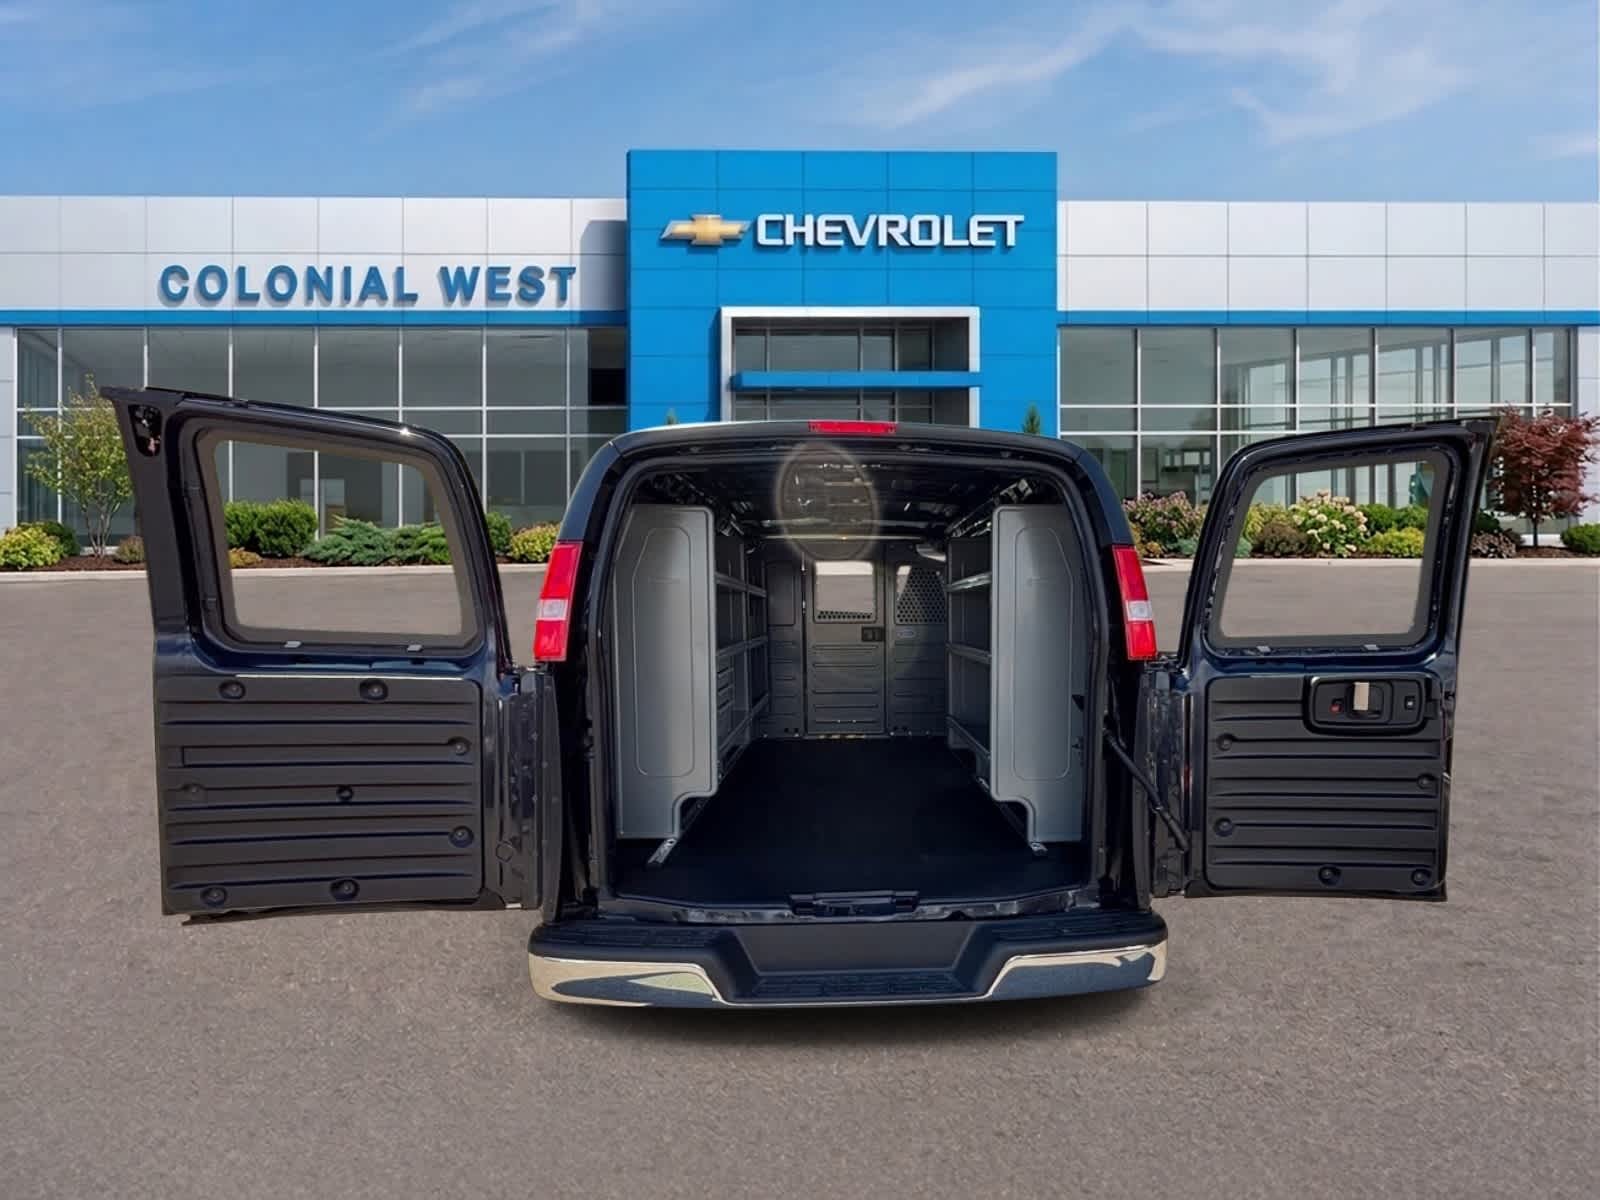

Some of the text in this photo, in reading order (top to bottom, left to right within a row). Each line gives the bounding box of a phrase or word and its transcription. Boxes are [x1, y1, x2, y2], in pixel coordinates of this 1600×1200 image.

[756, 214, 1024, 247] CHEVROLET
[160, 265, 576, 304] COLONIAL WEST
